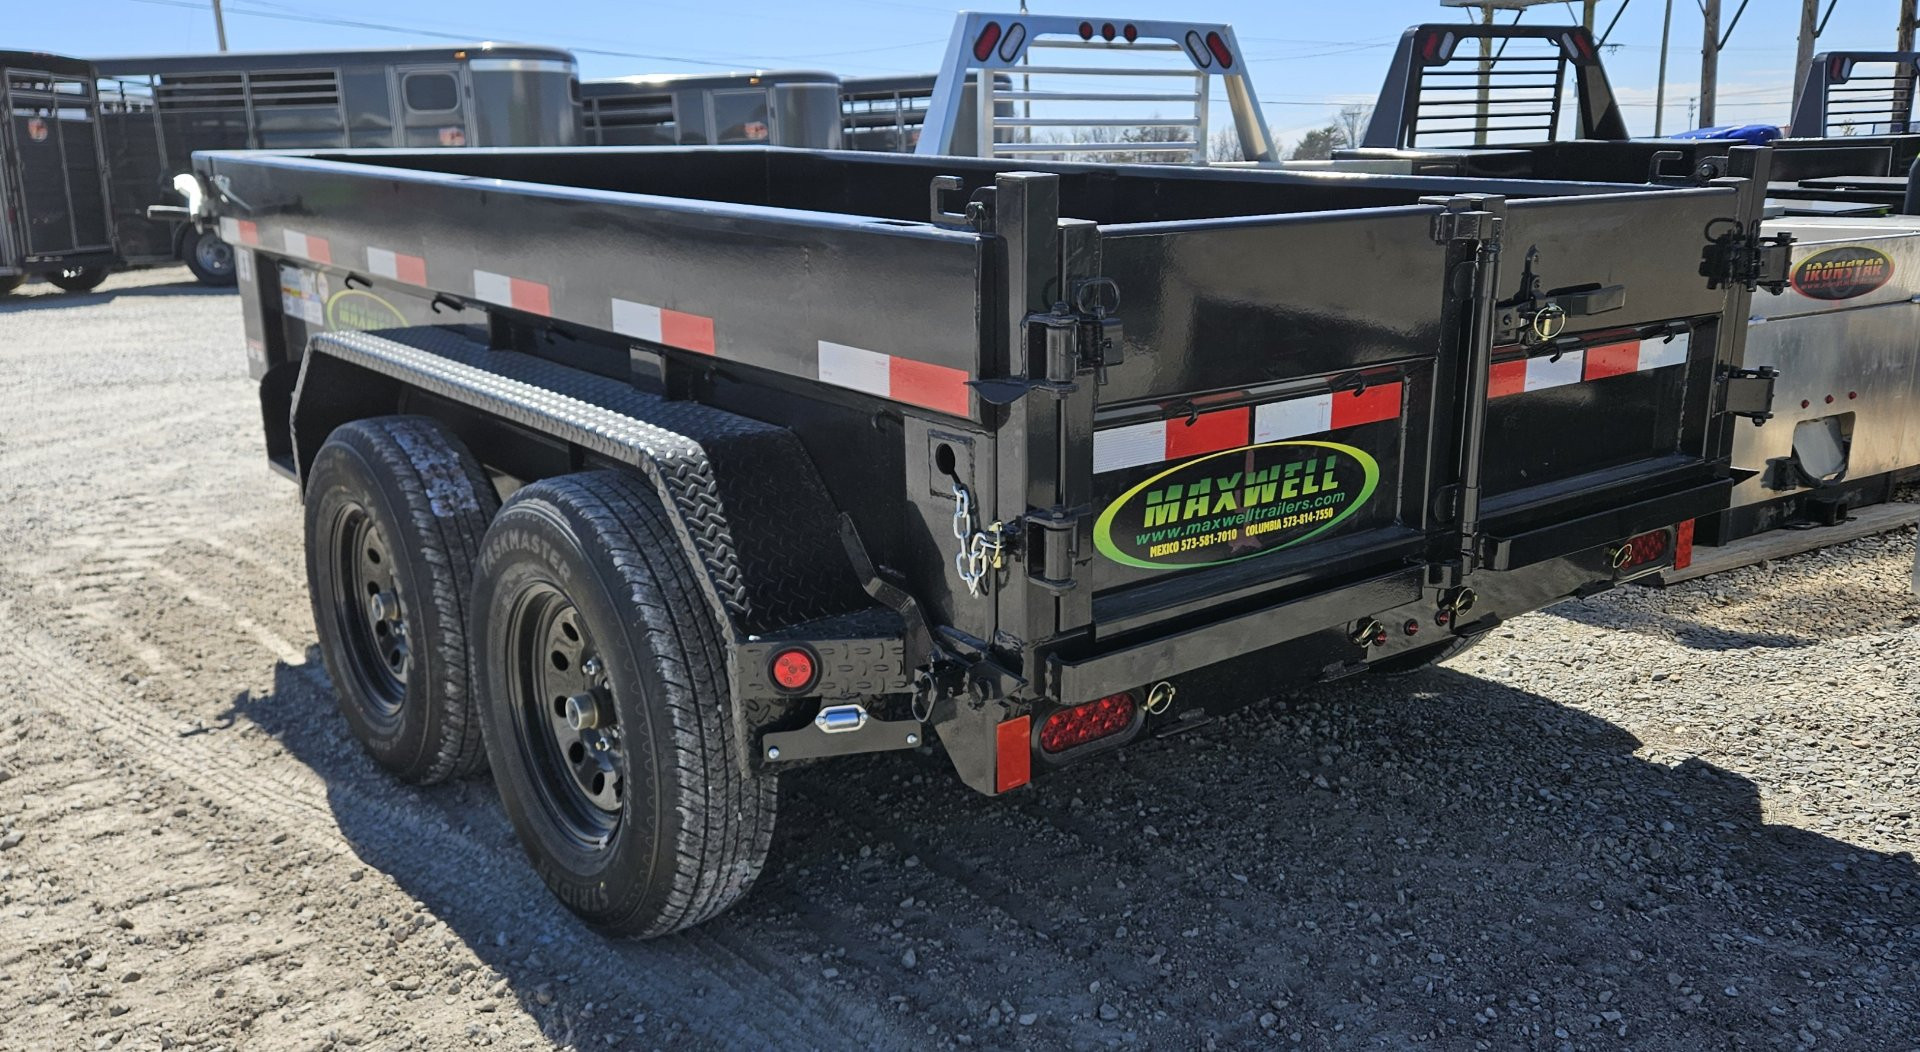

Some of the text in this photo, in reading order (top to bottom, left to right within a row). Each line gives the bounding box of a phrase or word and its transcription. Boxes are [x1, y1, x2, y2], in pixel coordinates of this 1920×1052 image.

[1804, 257, 1884, 282] IRONSTAR
[1136, 490, 1346, 546] www.maxwelltrailers.com
[1144, 455, 1338, 528] MAXWELL
[481, 528, 571, 583] TASKMASTER
[1150, 508, 1334, 557] MEXICO 573-581-7010 COLUMBIA 573-814-7550
